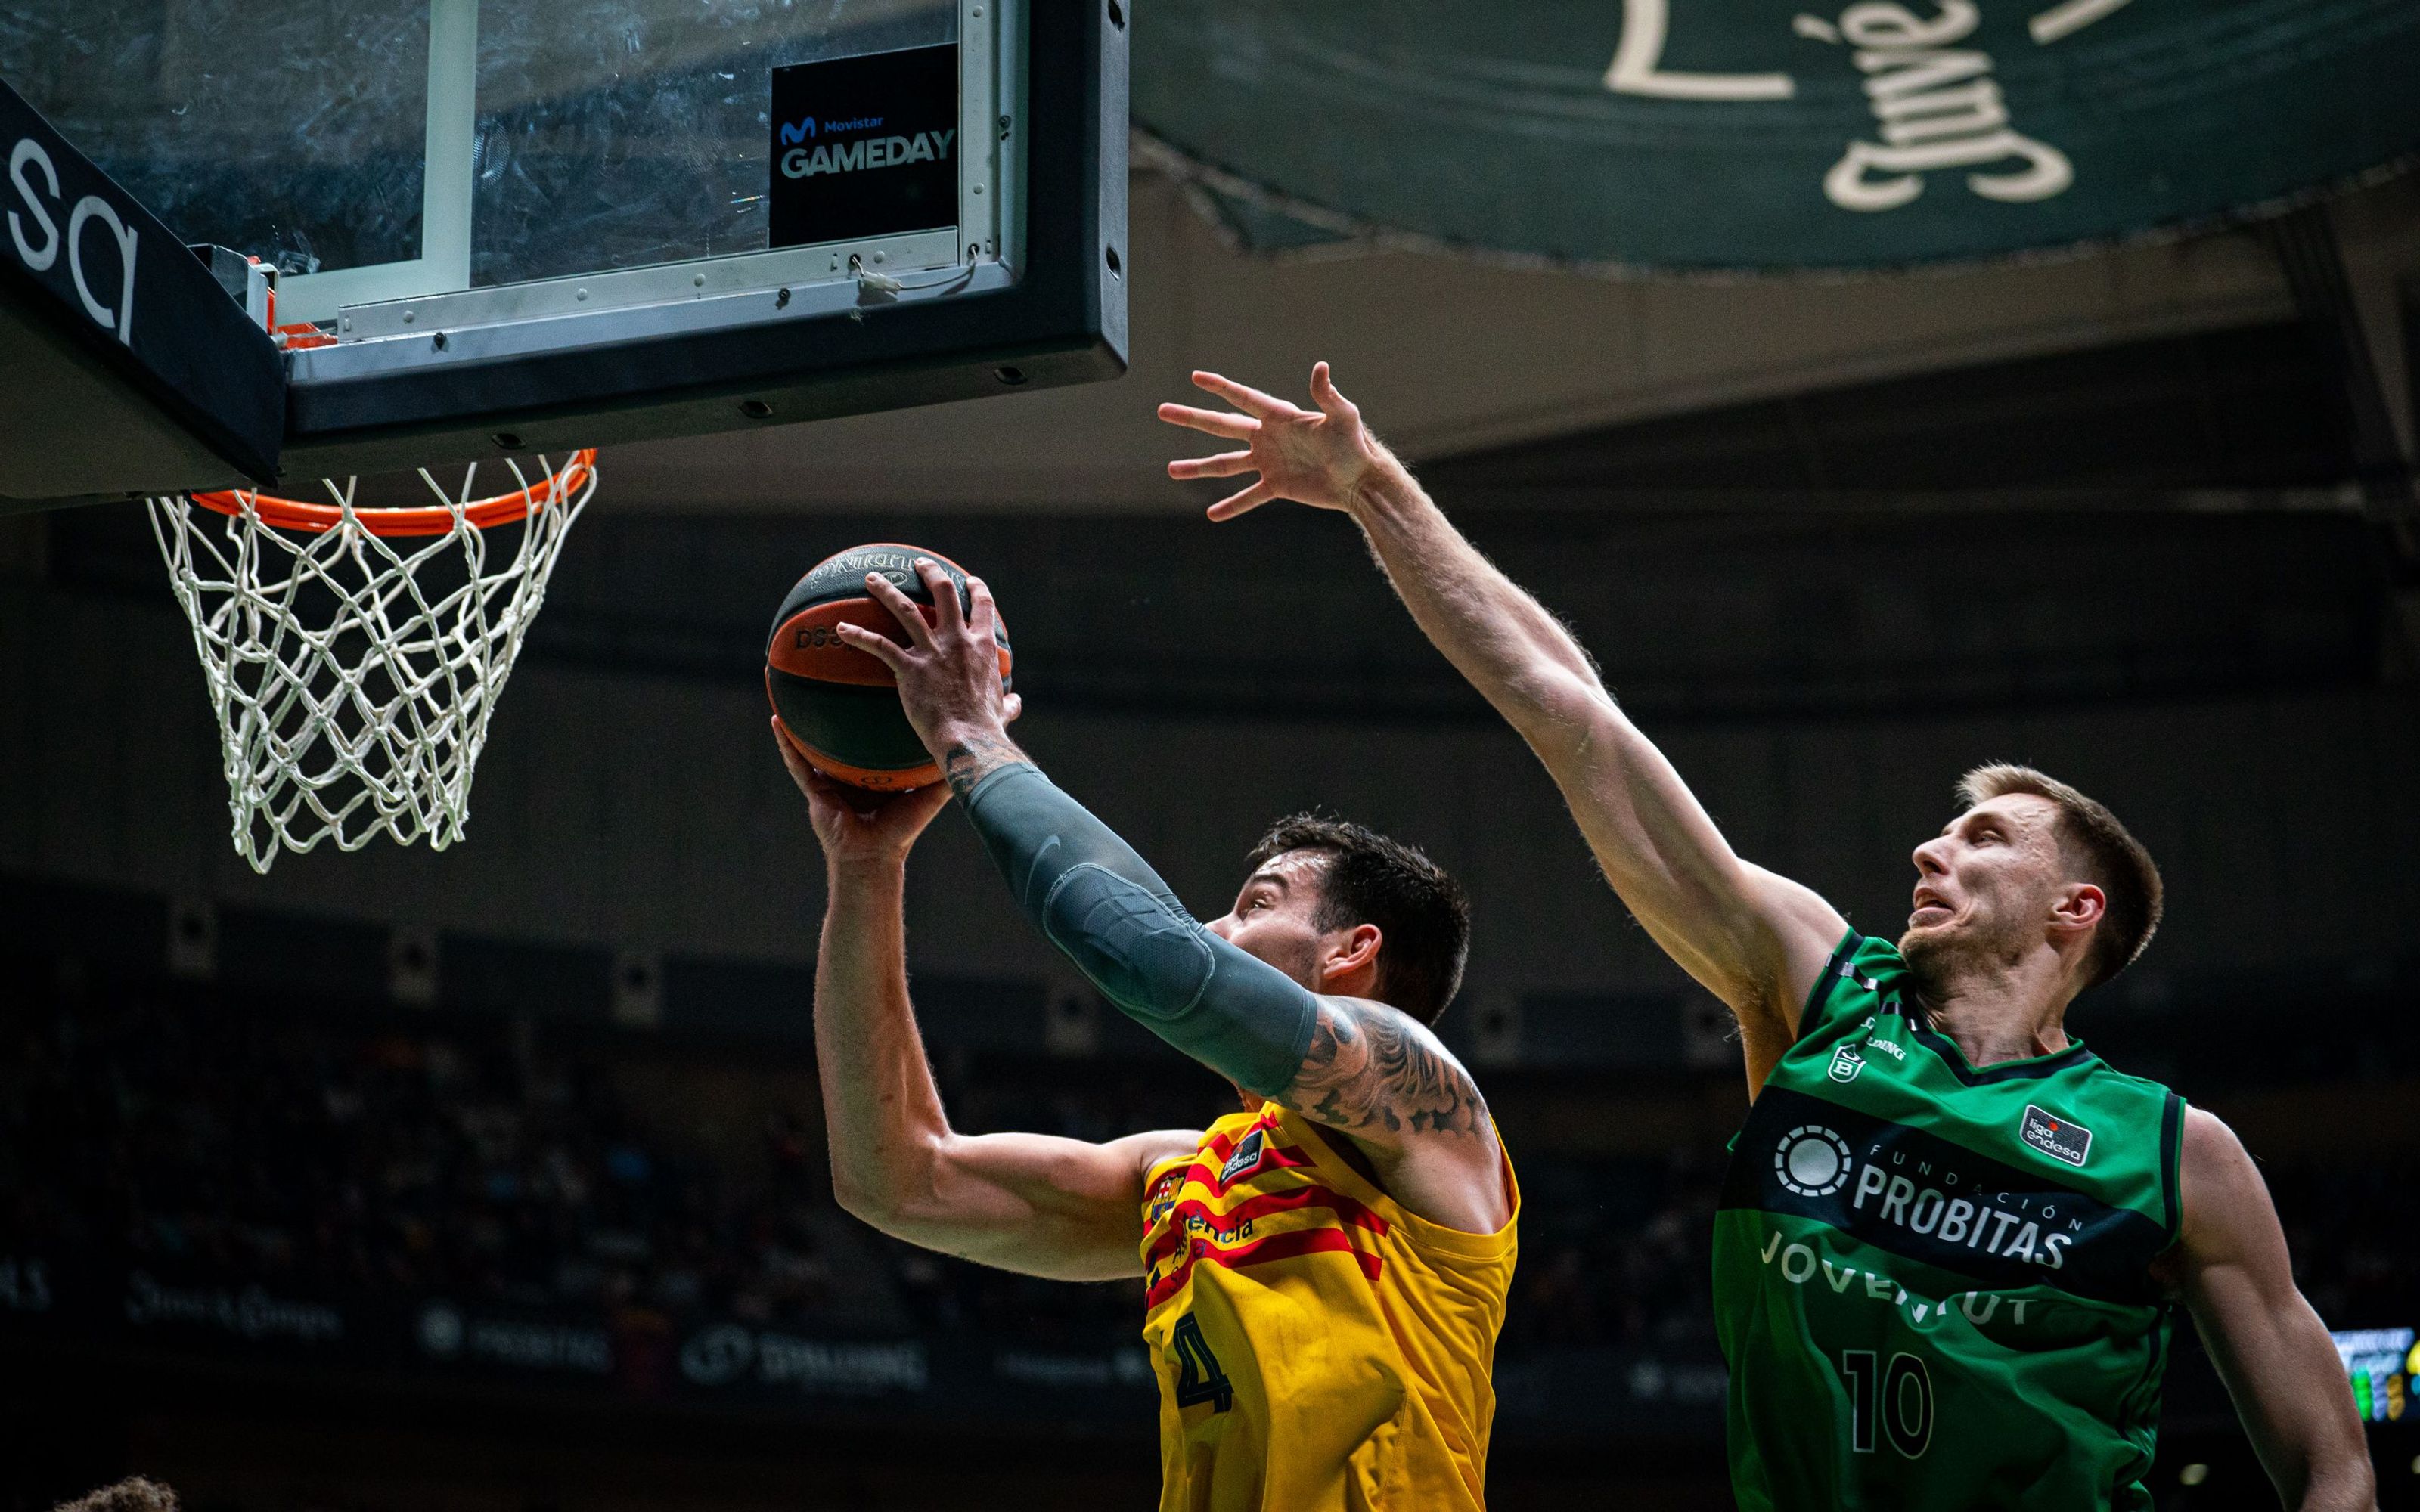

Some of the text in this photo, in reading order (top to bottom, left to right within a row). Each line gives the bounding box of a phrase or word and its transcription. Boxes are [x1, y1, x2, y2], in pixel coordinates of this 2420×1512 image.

[780, 129, 956, 179] GAMEDAY
[824, 117, 884, 133] Movistar
[2027, 1130, 2081, 1160] endesa
[2029, 1118, 2054, 1138] liga
[1221, 1152, 1258, 1179] endesa
[1869, 1144, 2083, 1232] FUNDACIÓN
[1853, 1163, 2072, 1270] PROBITAS
[1761, 1230, 2039, 1325] JOVENUT
[1160, 1311, 1234, 1414] 4
[1842, 1349, 1934, 1461] 10
